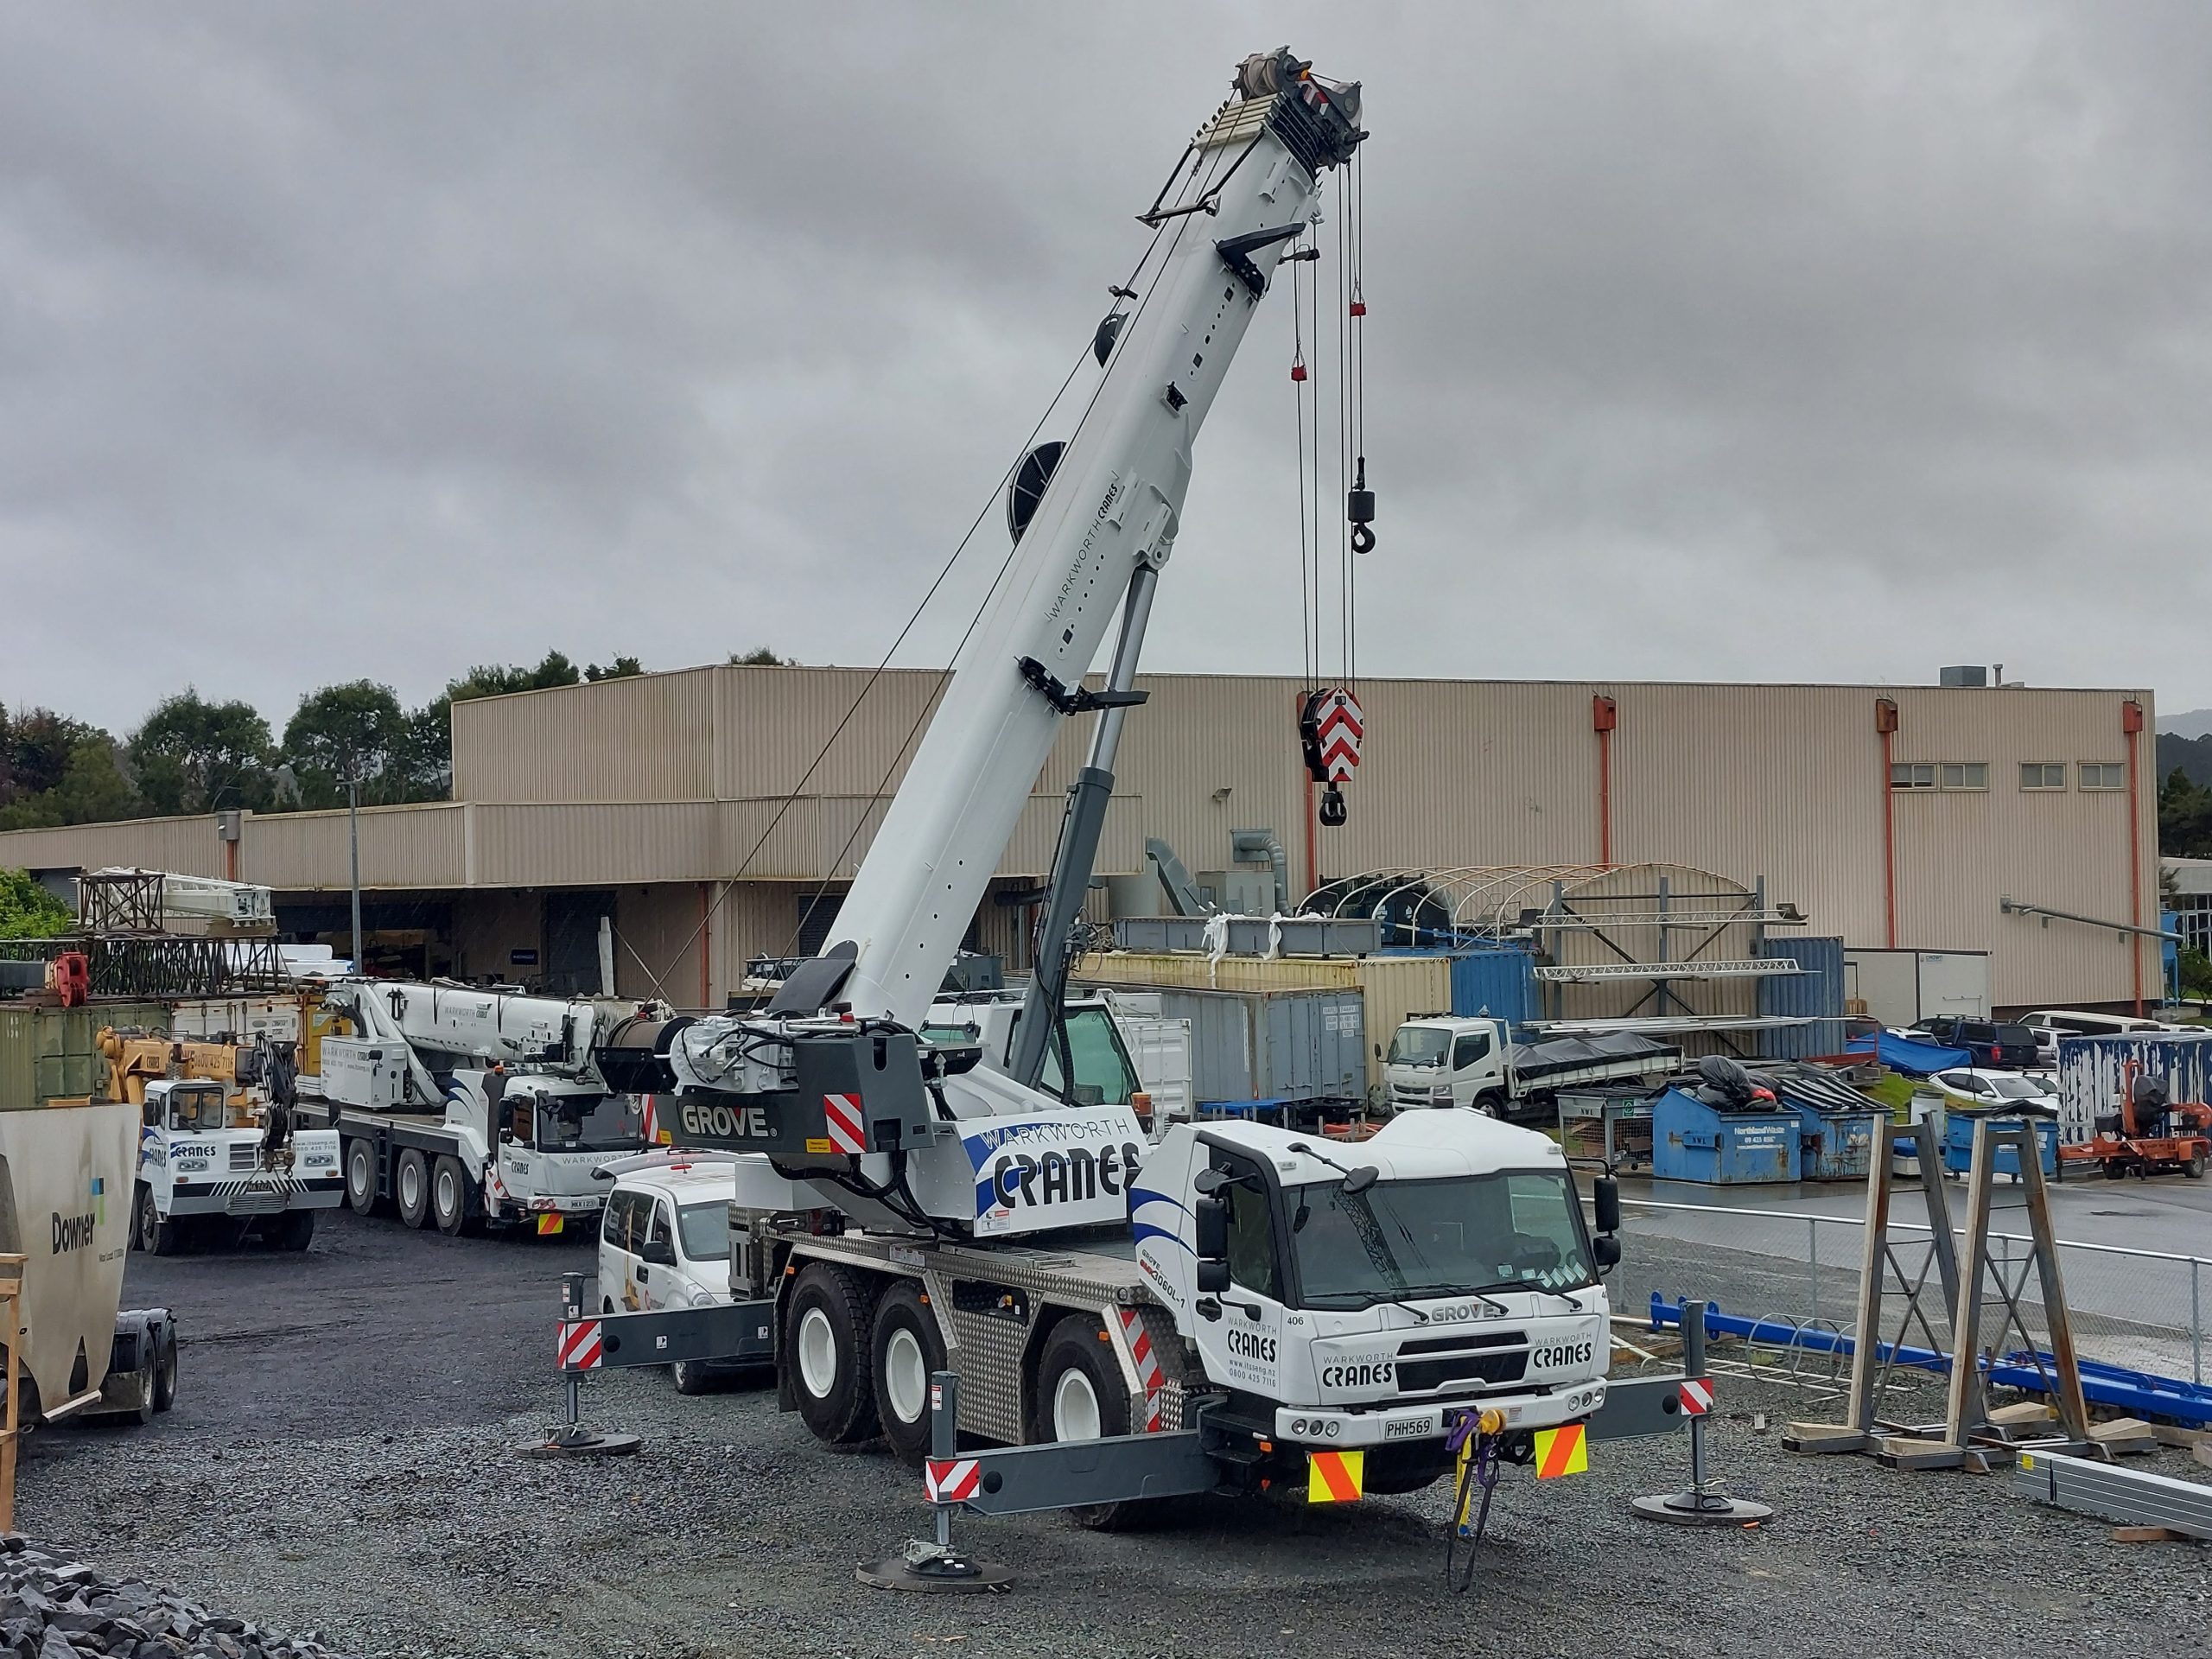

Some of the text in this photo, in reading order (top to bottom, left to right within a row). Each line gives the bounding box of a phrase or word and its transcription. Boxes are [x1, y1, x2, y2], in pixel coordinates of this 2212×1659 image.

[1050, 483, 1118, 619] WARKWORTH CRANES
[683, 1105, 769, 1138] GROVE
[978, 1117, 1131, 1151] WARKWORTH
[149, 1147, 167, 1168] CRANES
[175, 1146, 216, 1158] CRANES
[511, 1160, 529, 1175] CRANES
[994, 1141, 1140, 1210] CRANES
[52, 1211, 96, 1255] Downer
[1141, 1249, 1161, 1271] GROVE
[1287, 1316, 1304, 1326] 406
[1432, 1303, 1495, 1322] GROVE
[1227, 1316, 1277, 1335] WARKWORTH
[1227, 1329, 1277, 1363] CRANES
[1535, 1332, 1592, 1346] WARKWORTH
[1323, 1352, 1394, 1364] WARKWORTH
[1534, 1341, 1592, 1369] CRANES
[1229, 1368, 1276, 1388] 0800 425 7116
[1322, 1362, 1394, 1388] CRANES
[1386, 1419, 1431, 1438] PHH569
